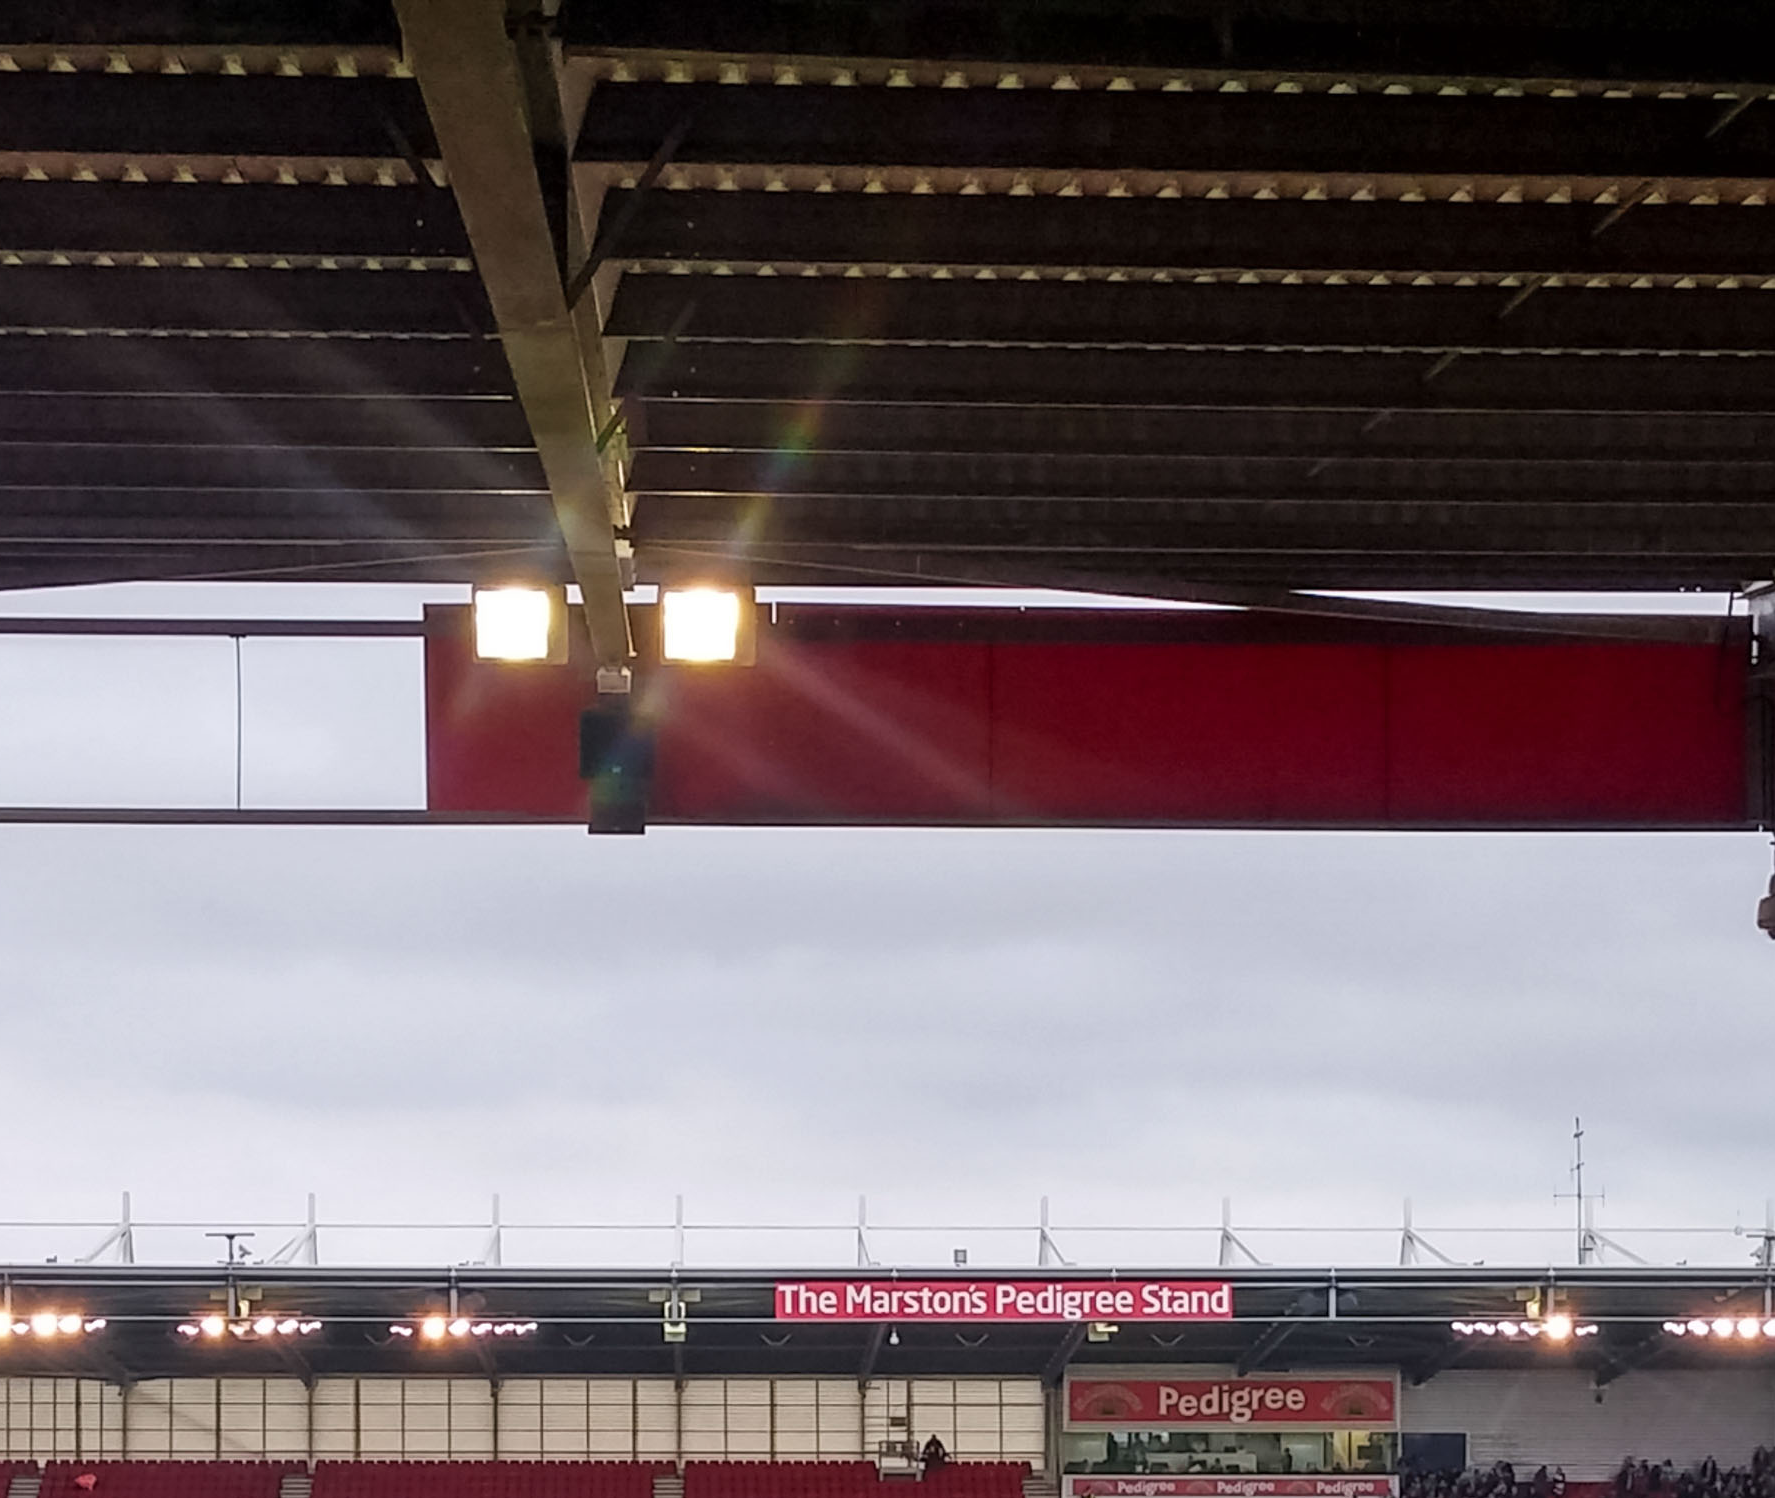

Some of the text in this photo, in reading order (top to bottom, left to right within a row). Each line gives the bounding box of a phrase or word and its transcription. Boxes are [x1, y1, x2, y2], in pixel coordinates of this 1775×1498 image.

[777, 1284, 1229, 1320] The Marston's Pedigree Stand
[1158, 1384, 1306, 1422] Pedigree
[1117, 1481, 1175, 1496] Pedigree
[1216, 1481, 1275, 1496] Pedigree
[1316, 1481, 1374, 1497] Pedigree
